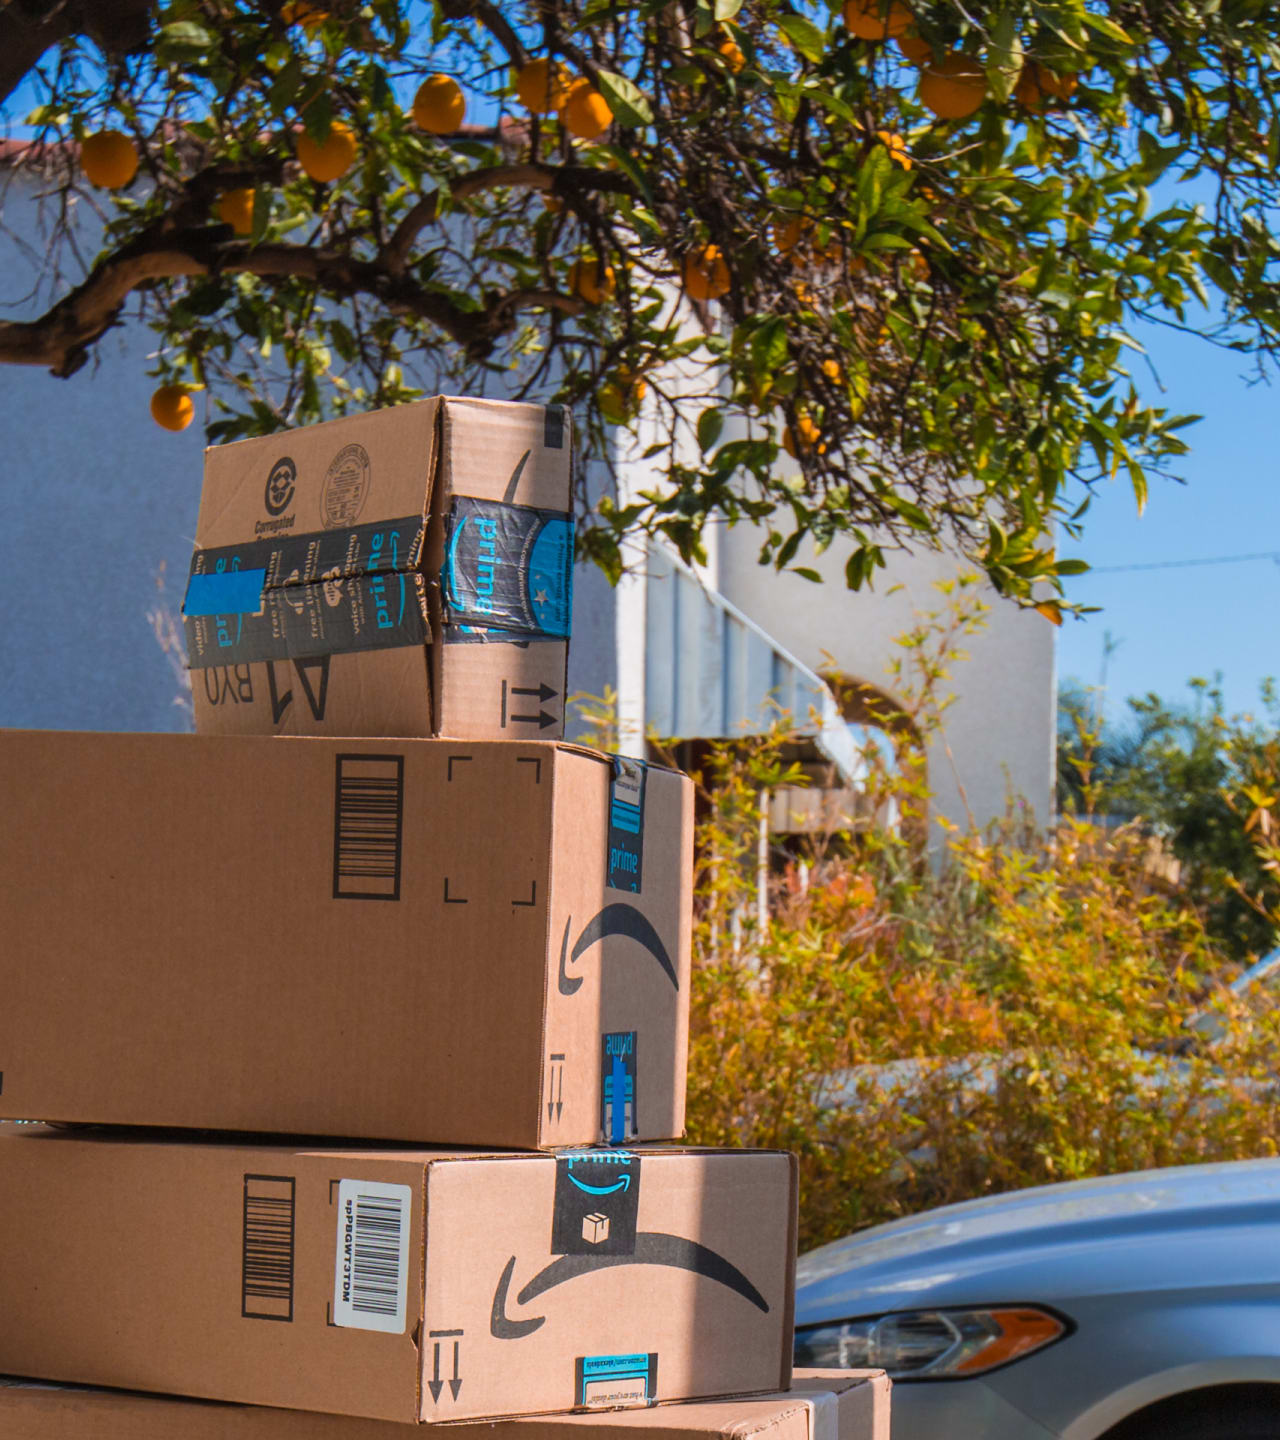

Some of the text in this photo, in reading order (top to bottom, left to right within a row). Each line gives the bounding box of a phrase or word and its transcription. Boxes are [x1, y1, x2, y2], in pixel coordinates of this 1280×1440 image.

[265, 552, 277, 606] reding
[474, 516, 503, 616] prime
[309, 610, 318, 640] free
[351, 600, 360, 635] voice
[610, 842, 638, 874] prime
[567, 1150, 632, 1169] prime
